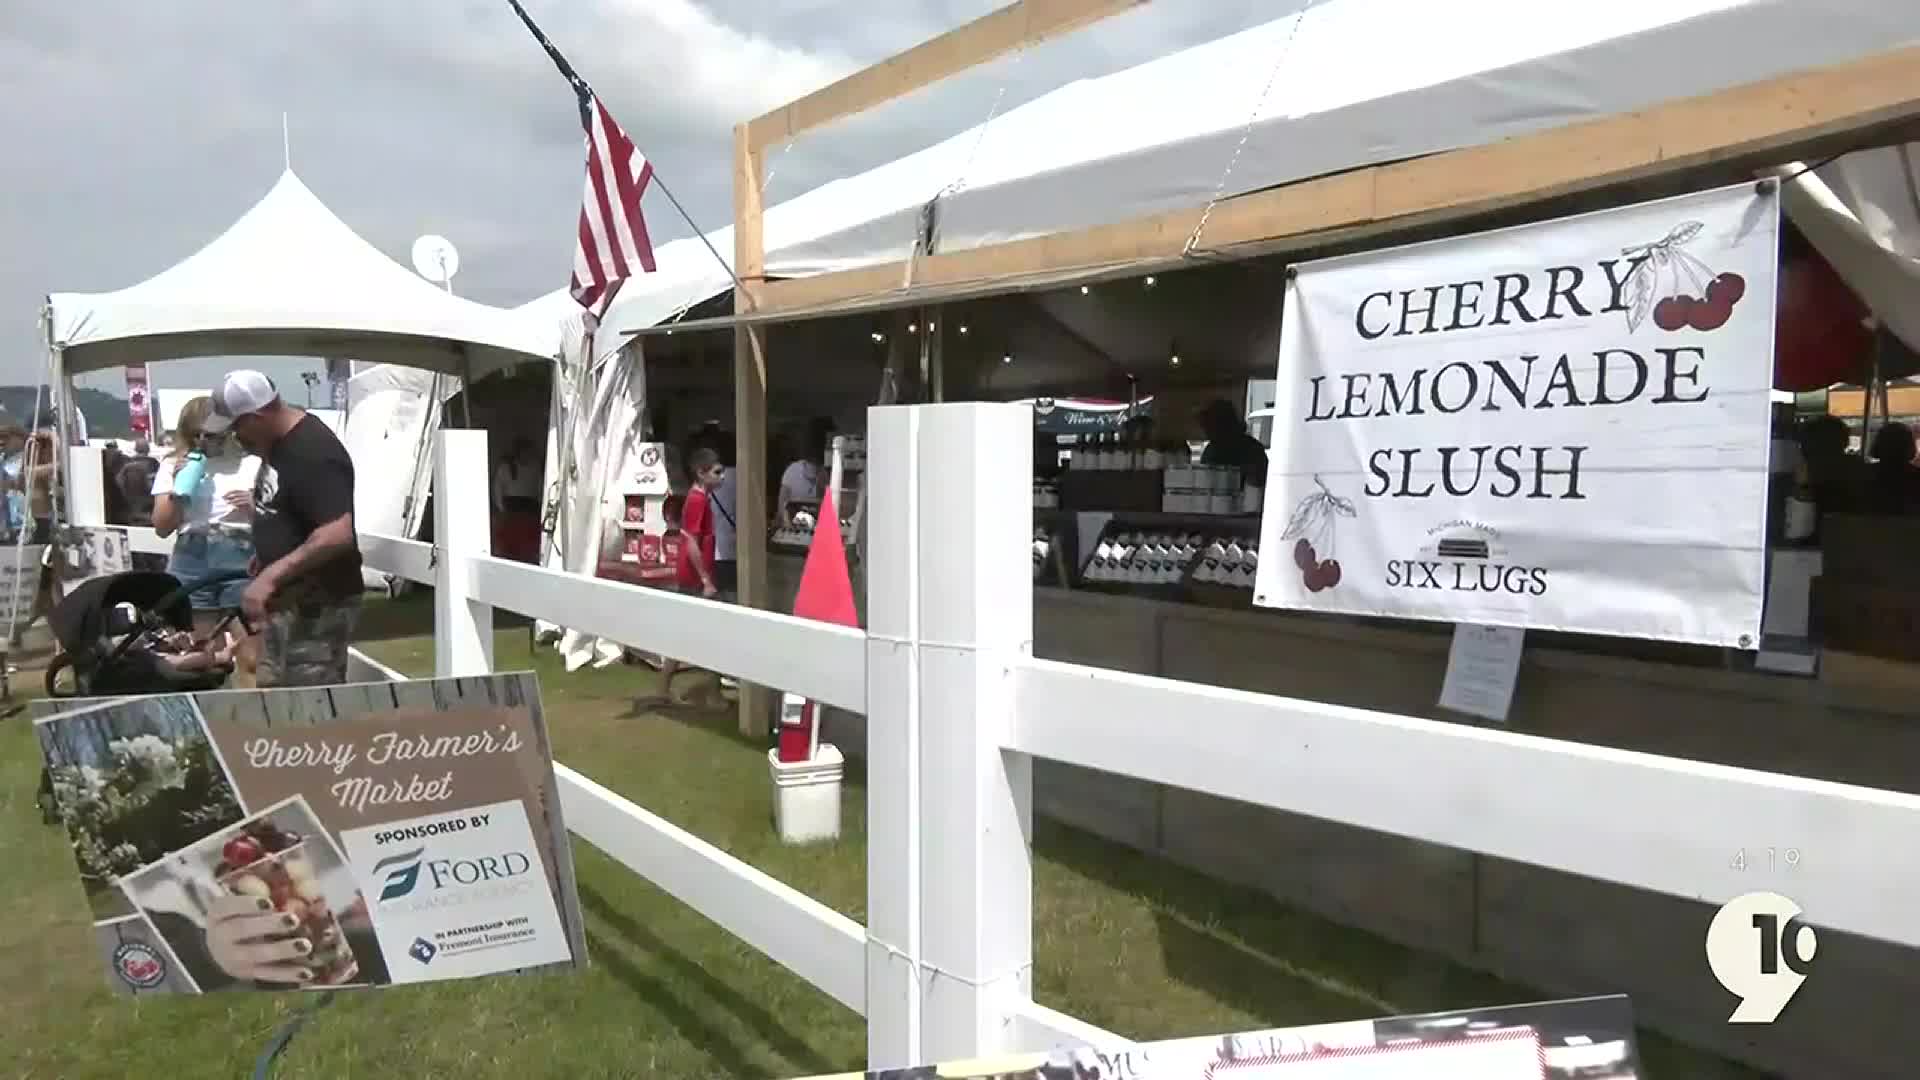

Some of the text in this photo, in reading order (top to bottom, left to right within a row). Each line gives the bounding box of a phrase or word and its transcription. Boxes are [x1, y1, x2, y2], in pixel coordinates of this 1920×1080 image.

[1355, 256, 1650, 340] CHERRY
[1305, 347, 1711, 423] LEMONADE
[1363, 445, 1589, 500] SLUSH
[1426, 519, 1473, 536] MICHIGAN
[1386, 560, 1549, 596] SIX LUGS
[244, 724, 523, 774] Cherry Farmer's
[331, 771, 453, 814] Market
[375, 814, 491, 845] SPONSORED BY
[428, 851, 530, 889] FORD
[435, 916, 529, 940] IN PARTNERSHIP WITH
[438, 928, 537, 952] Fremont Insurance
